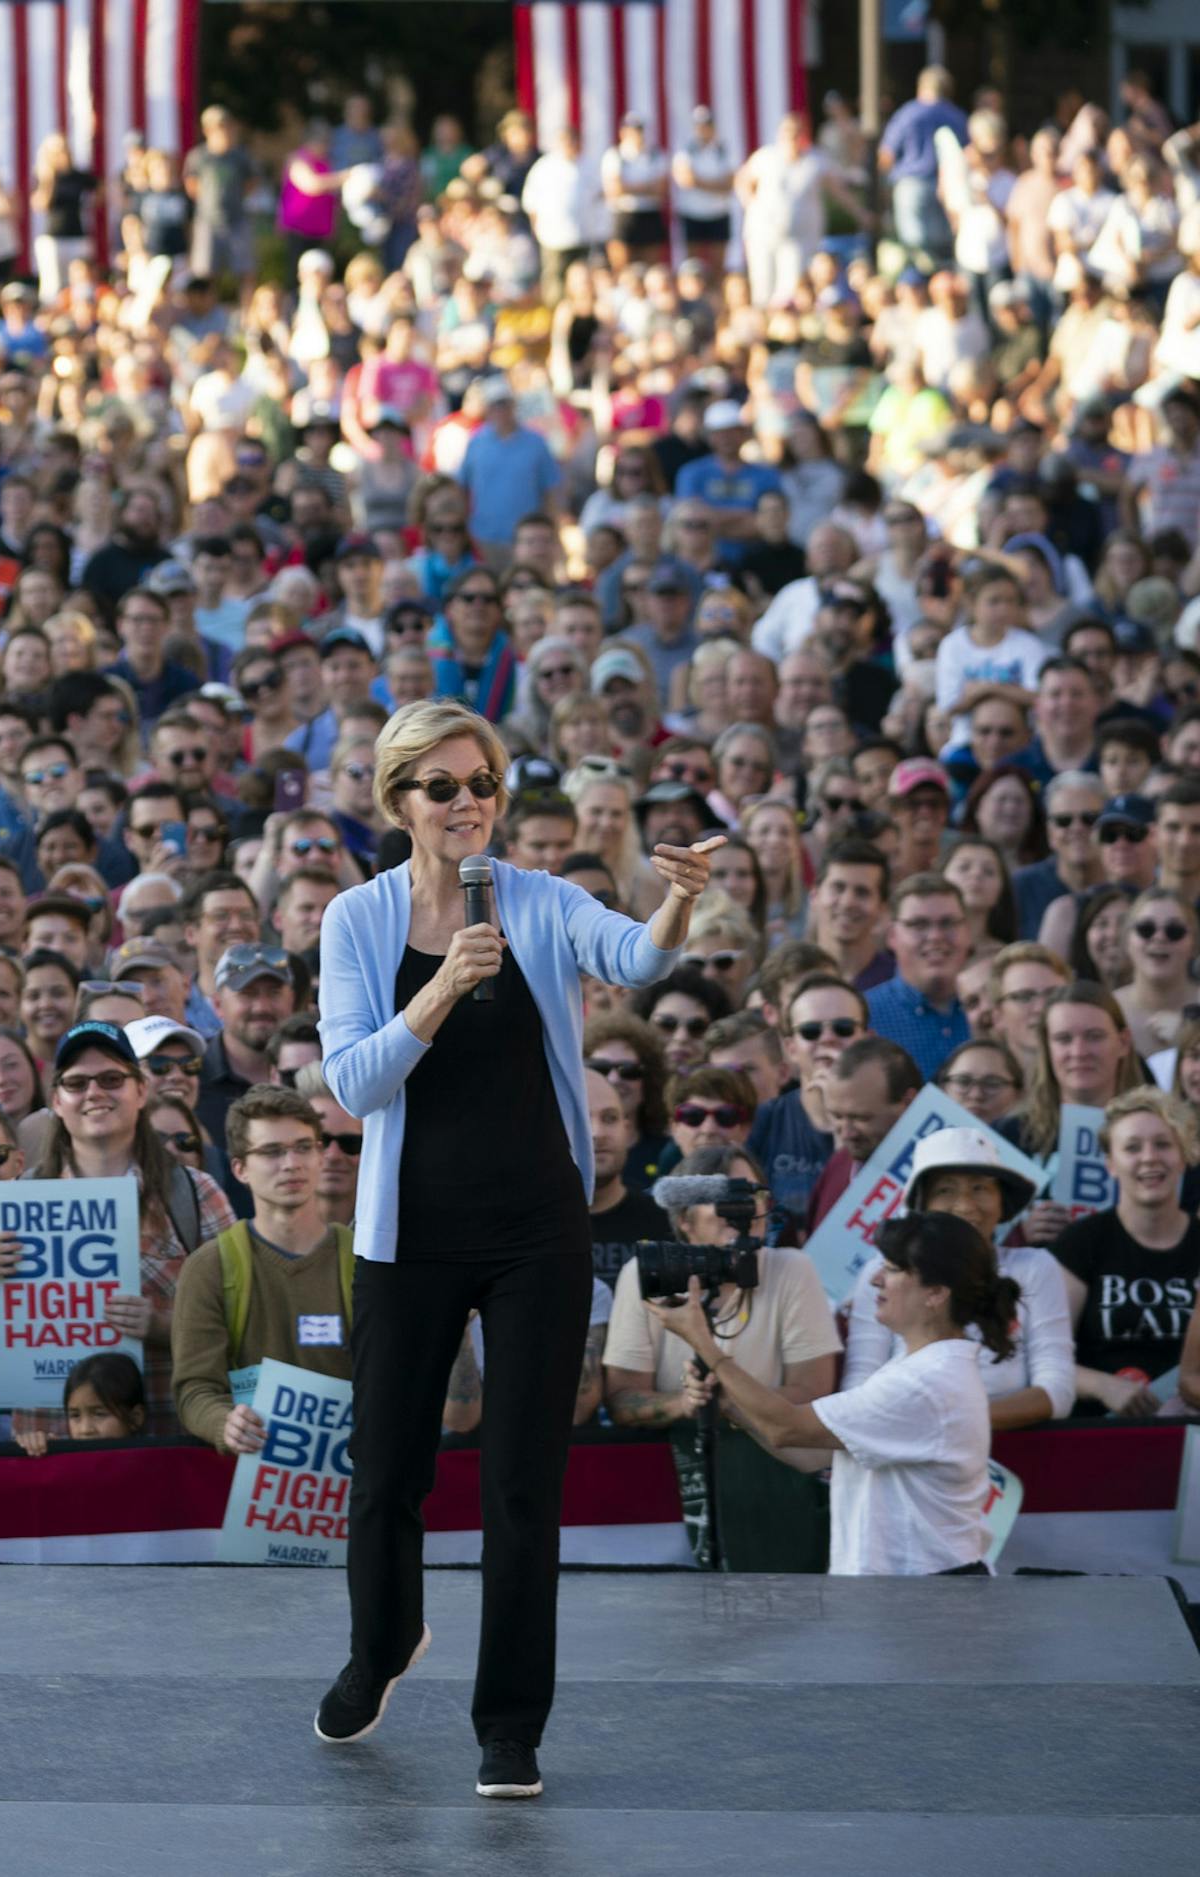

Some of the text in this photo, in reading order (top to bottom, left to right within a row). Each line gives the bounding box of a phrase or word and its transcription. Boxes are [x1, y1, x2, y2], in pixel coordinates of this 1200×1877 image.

[2, 1199, 117, 1233] DREAM
[5, 1234, 119, 1279] BIG
[4, 1280, 120, 1320] FIGHT
[1098, 1274, 1196, 1307] BOS
[5, 1322, 122, 1348] HARD
[34, 1359, 78, 1376] WARR
[272, 1385, 354, 1431] DREA
[252, 1464, 351, 1513] FIGH
[267, 1543, 330, 1563] WARREN
